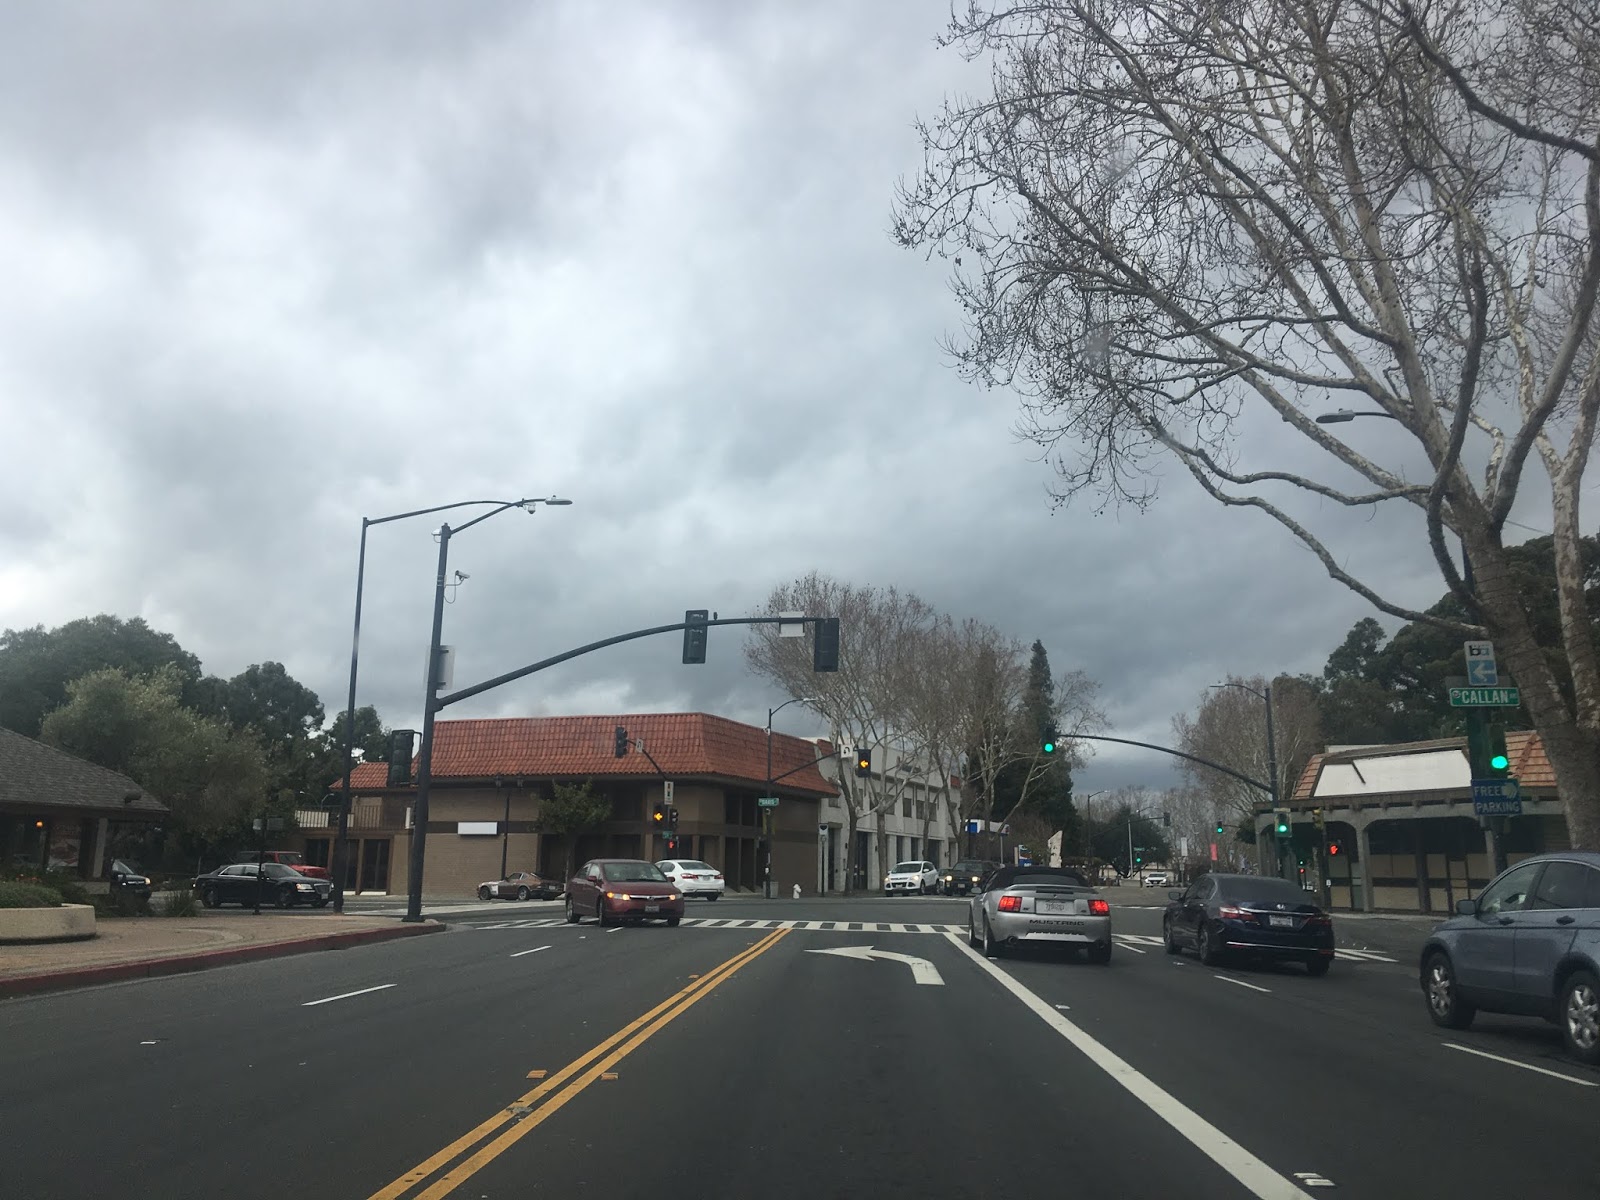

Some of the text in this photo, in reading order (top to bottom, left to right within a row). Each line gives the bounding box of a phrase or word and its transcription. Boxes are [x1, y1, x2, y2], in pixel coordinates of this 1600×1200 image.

[1461, 690, 1509, 704] CALLAN
[1474, 785, 1501, 797] FREE
[1476, 801, 1520, 813] PARKING
